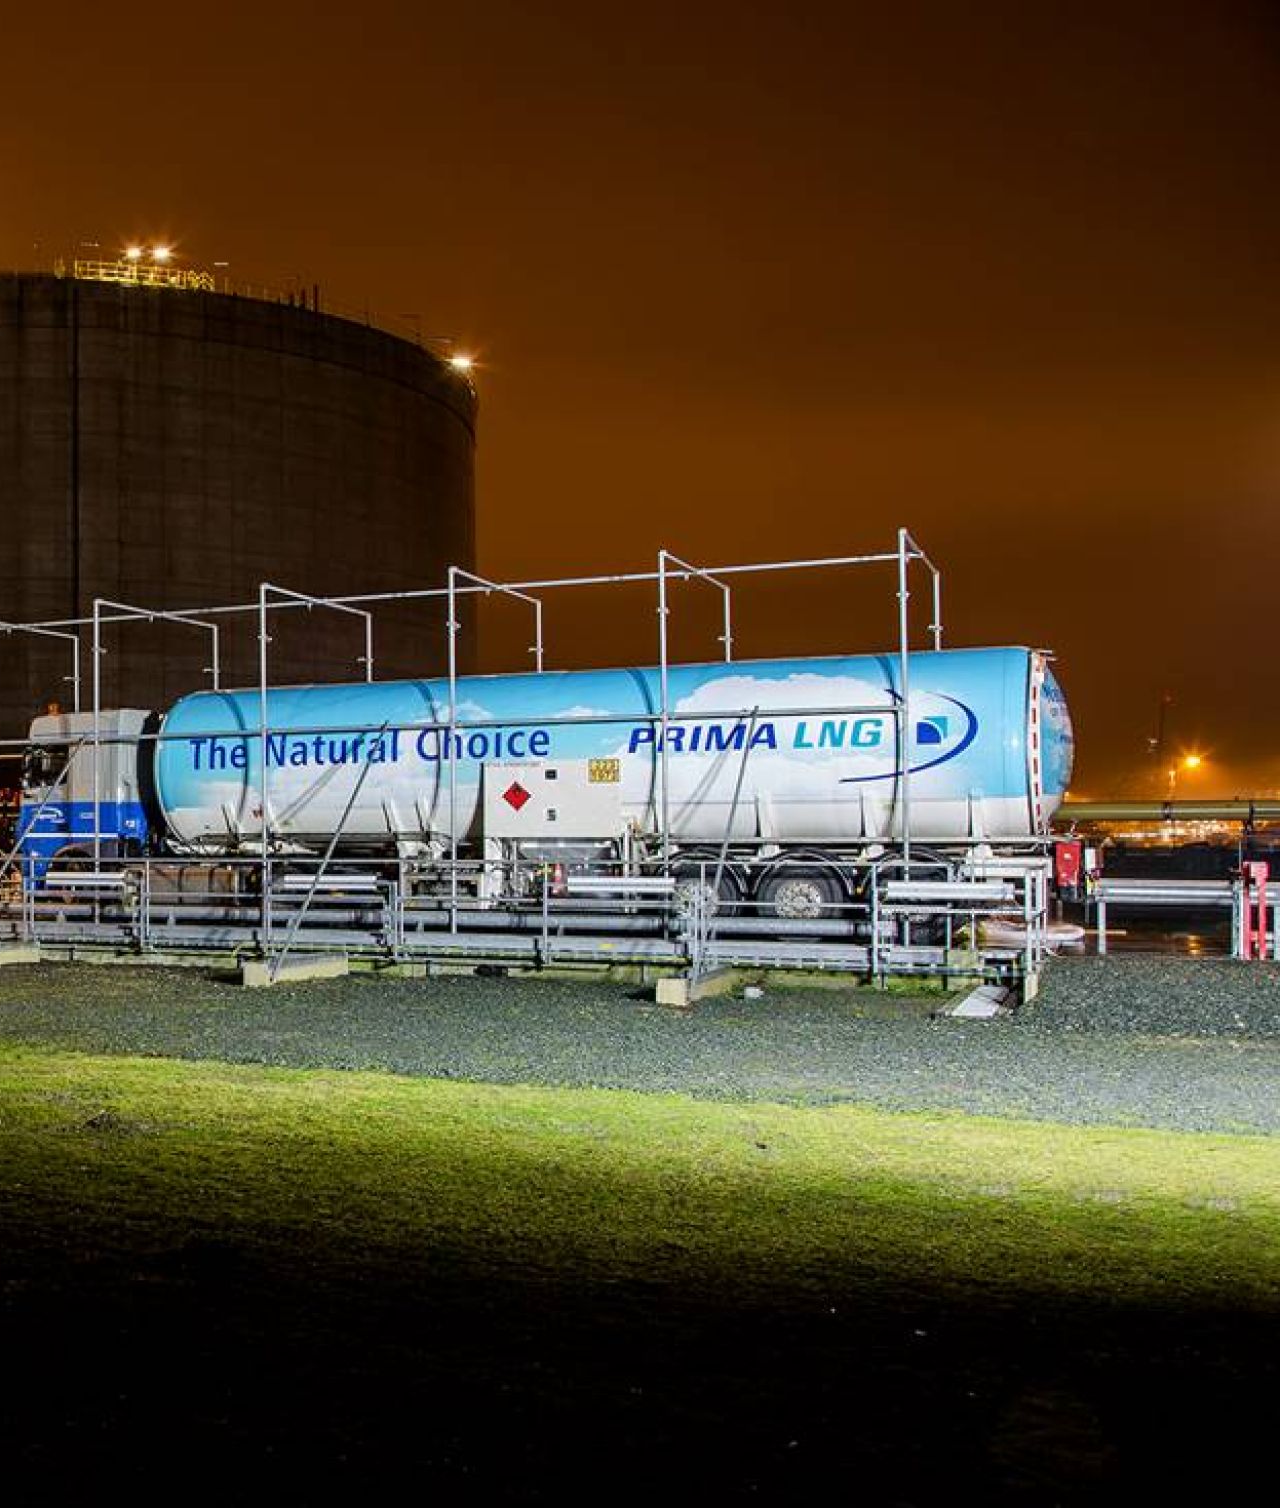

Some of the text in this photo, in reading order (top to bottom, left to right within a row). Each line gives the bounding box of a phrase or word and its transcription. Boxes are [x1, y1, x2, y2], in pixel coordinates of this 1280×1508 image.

[189, 725, 550, 770] The Natural Choice
[628, 719, 883, 754] PRIMA LNG
